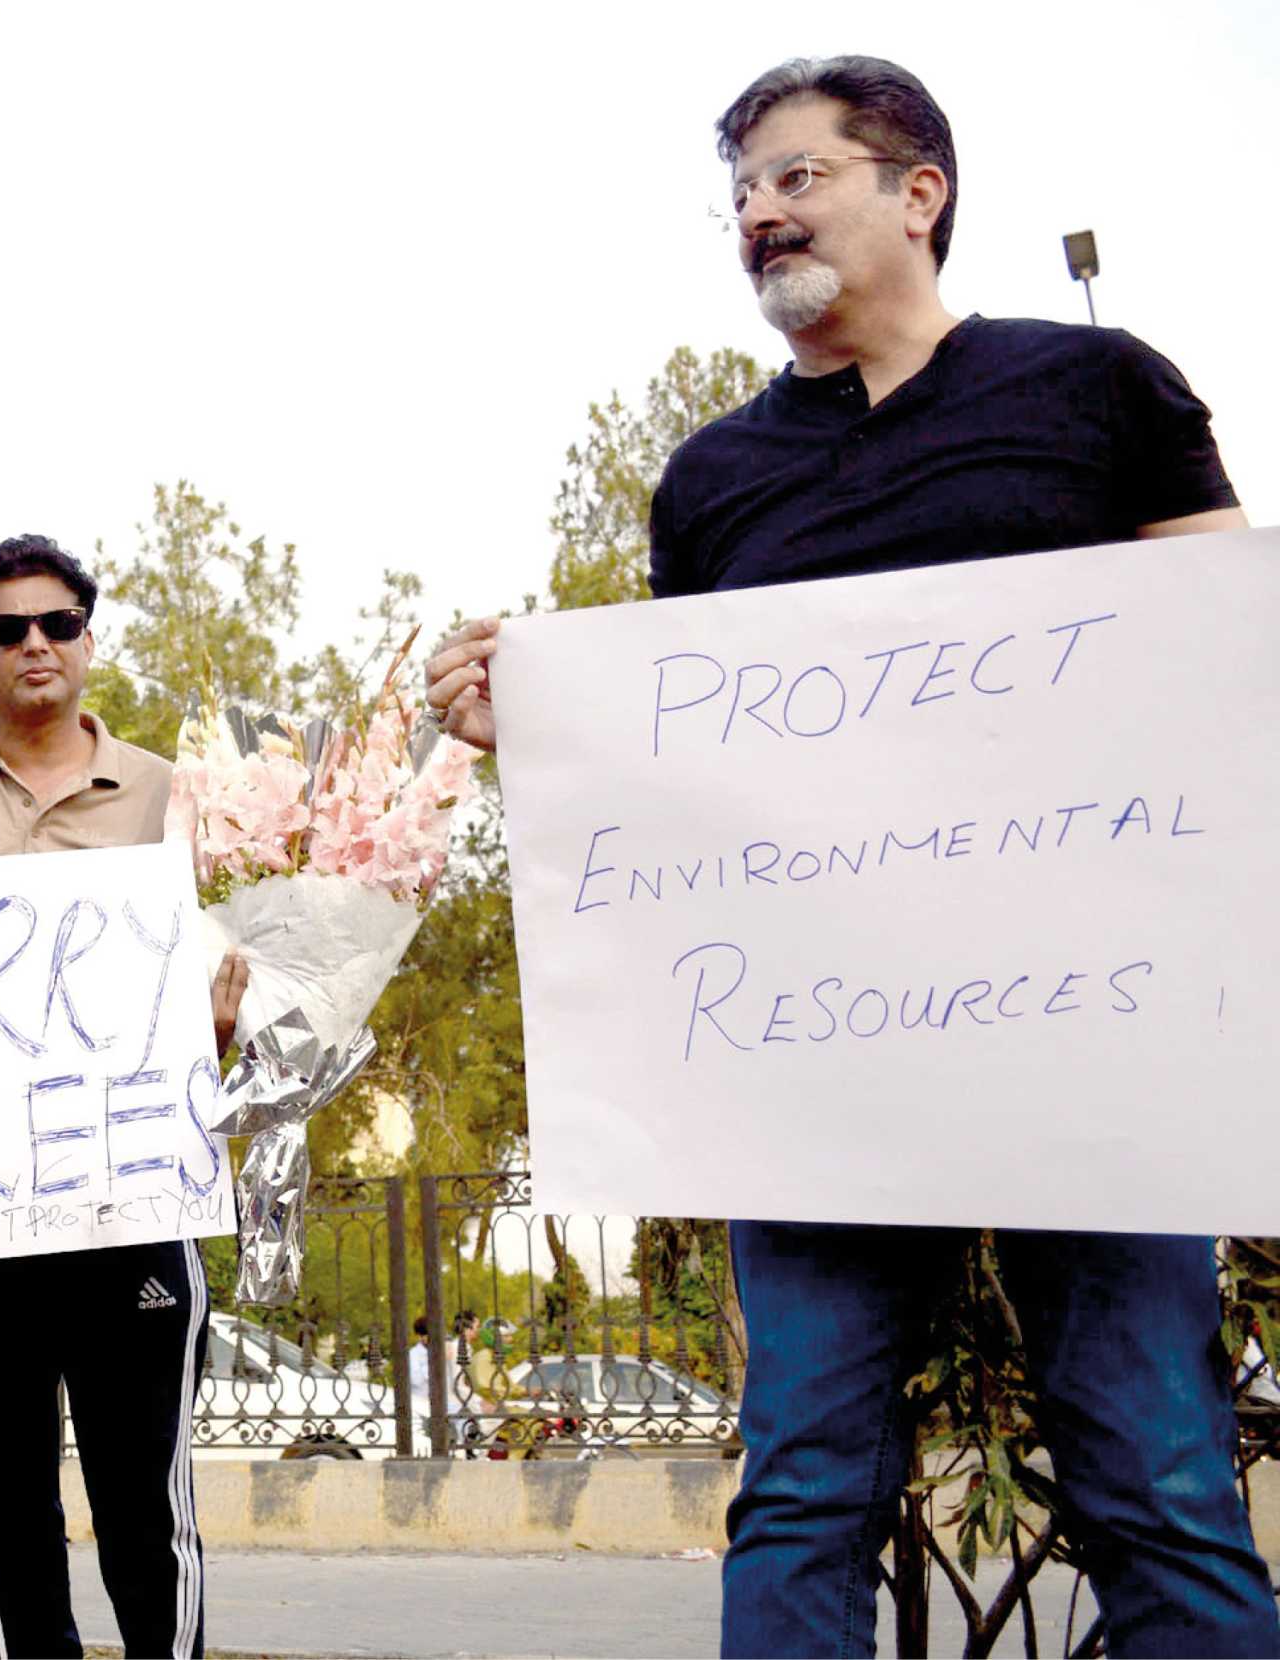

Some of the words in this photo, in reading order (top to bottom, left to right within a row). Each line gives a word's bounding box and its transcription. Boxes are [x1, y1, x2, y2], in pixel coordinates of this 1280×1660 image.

[652, 613, 1117, 756] PROTECT
[573, 794, 1206, 914] ENVIRONMENTAL
[671, 942, 1154, 1062] RESOURCES
[24, 1194, 163, 1240] PROTECT
[167, 1188, 224, 1235] YOU
